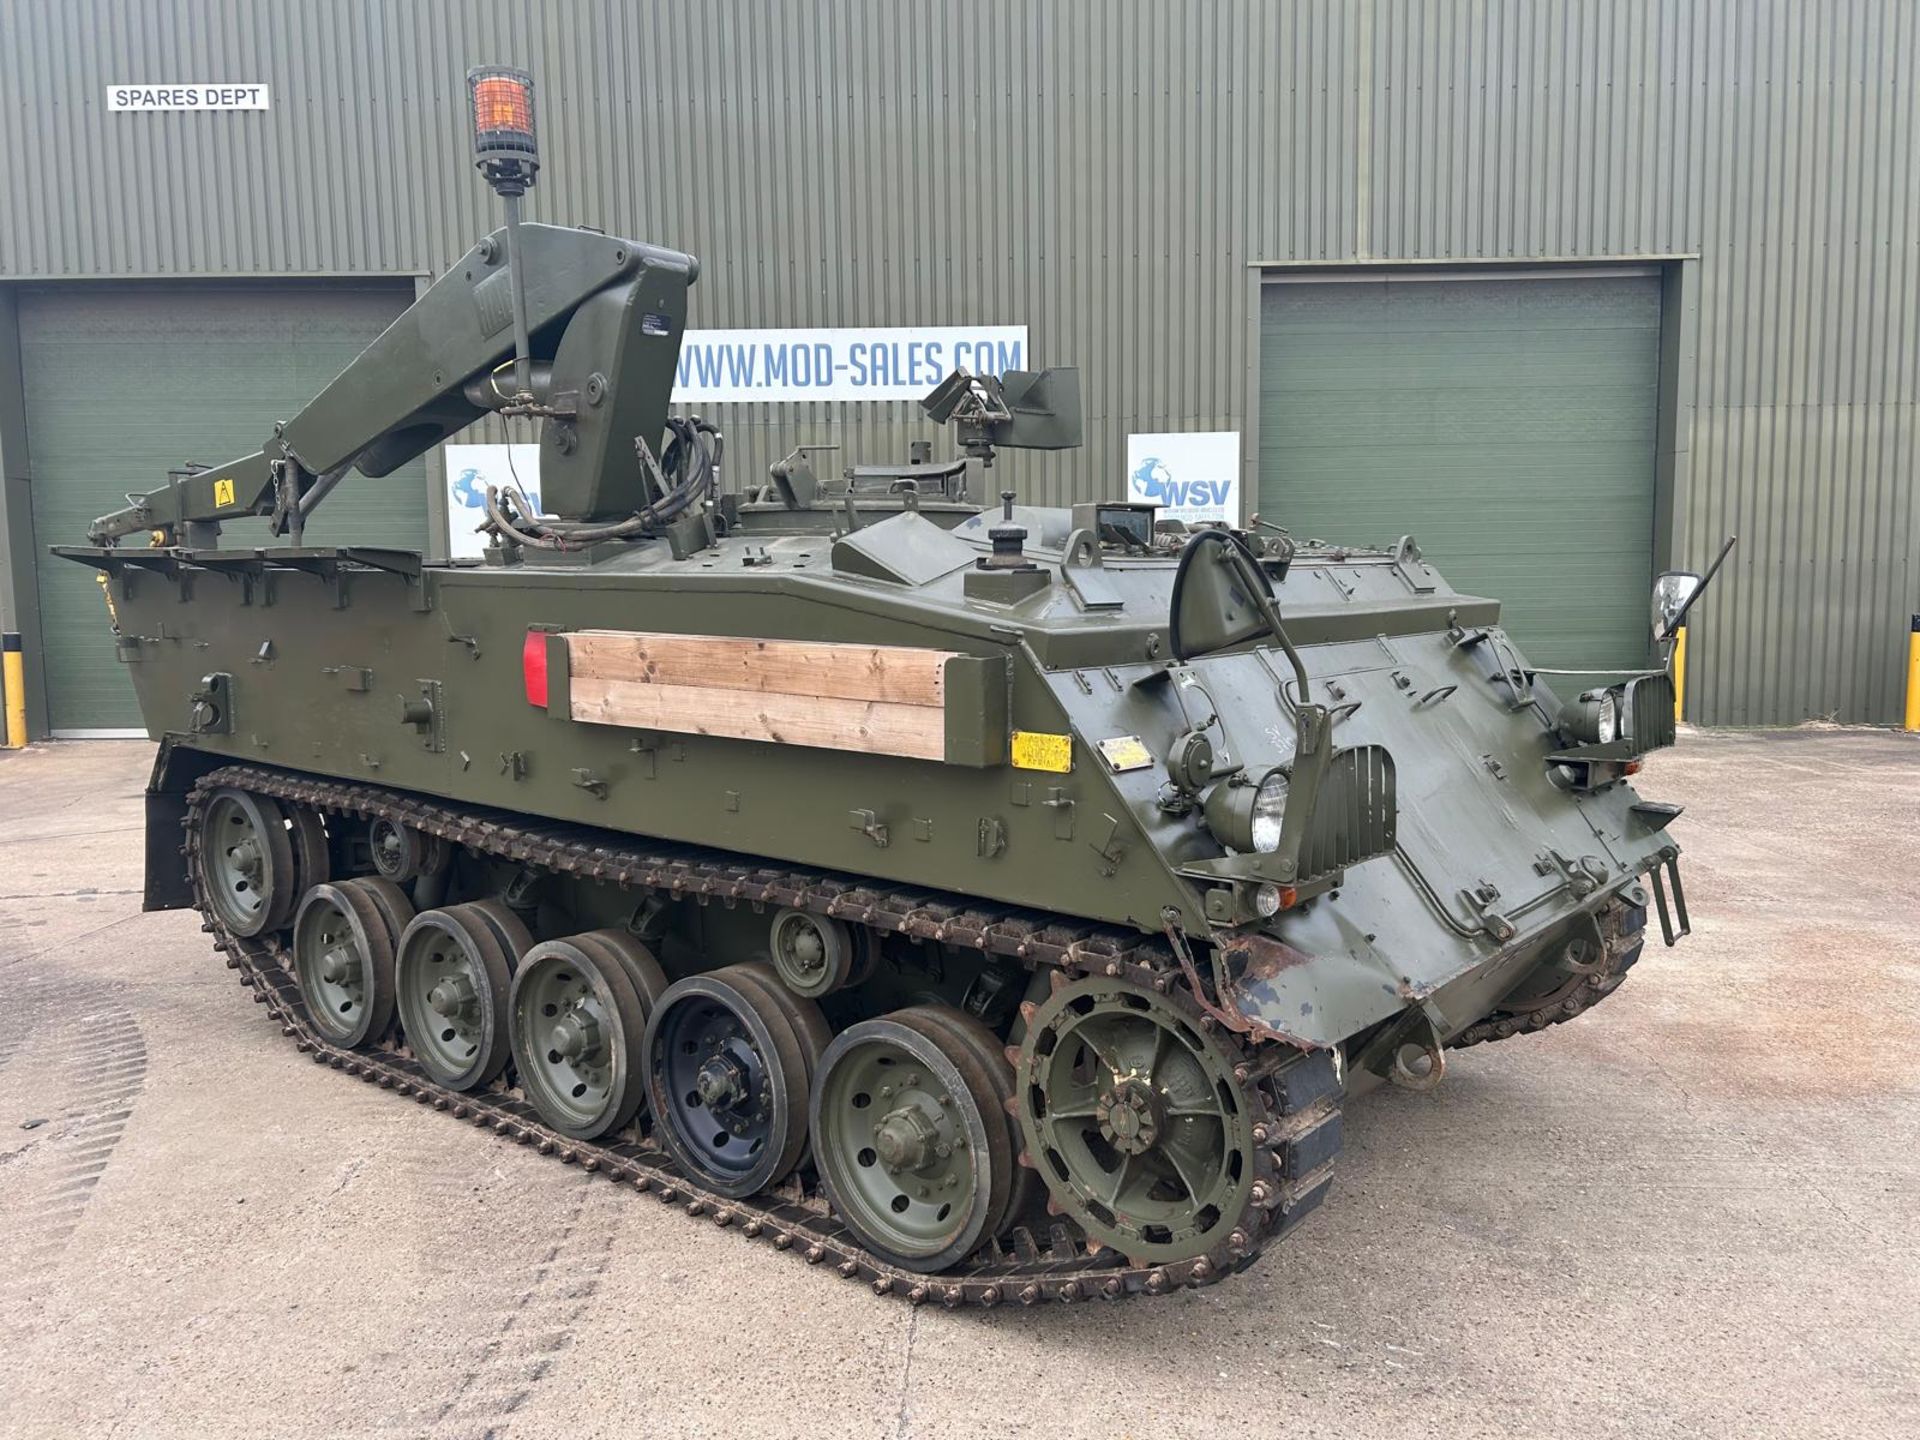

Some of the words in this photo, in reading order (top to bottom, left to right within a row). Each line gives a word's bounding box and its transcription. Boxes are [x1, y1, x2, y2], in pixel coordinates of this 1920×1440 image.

[116, 89, 198, 106] SPARES
[206, 88, 260, 105] DEPT
[672, 340, 1021, 388] WW.MOD-SALESCOM
[1160, 480, 1231, 506] WSV
